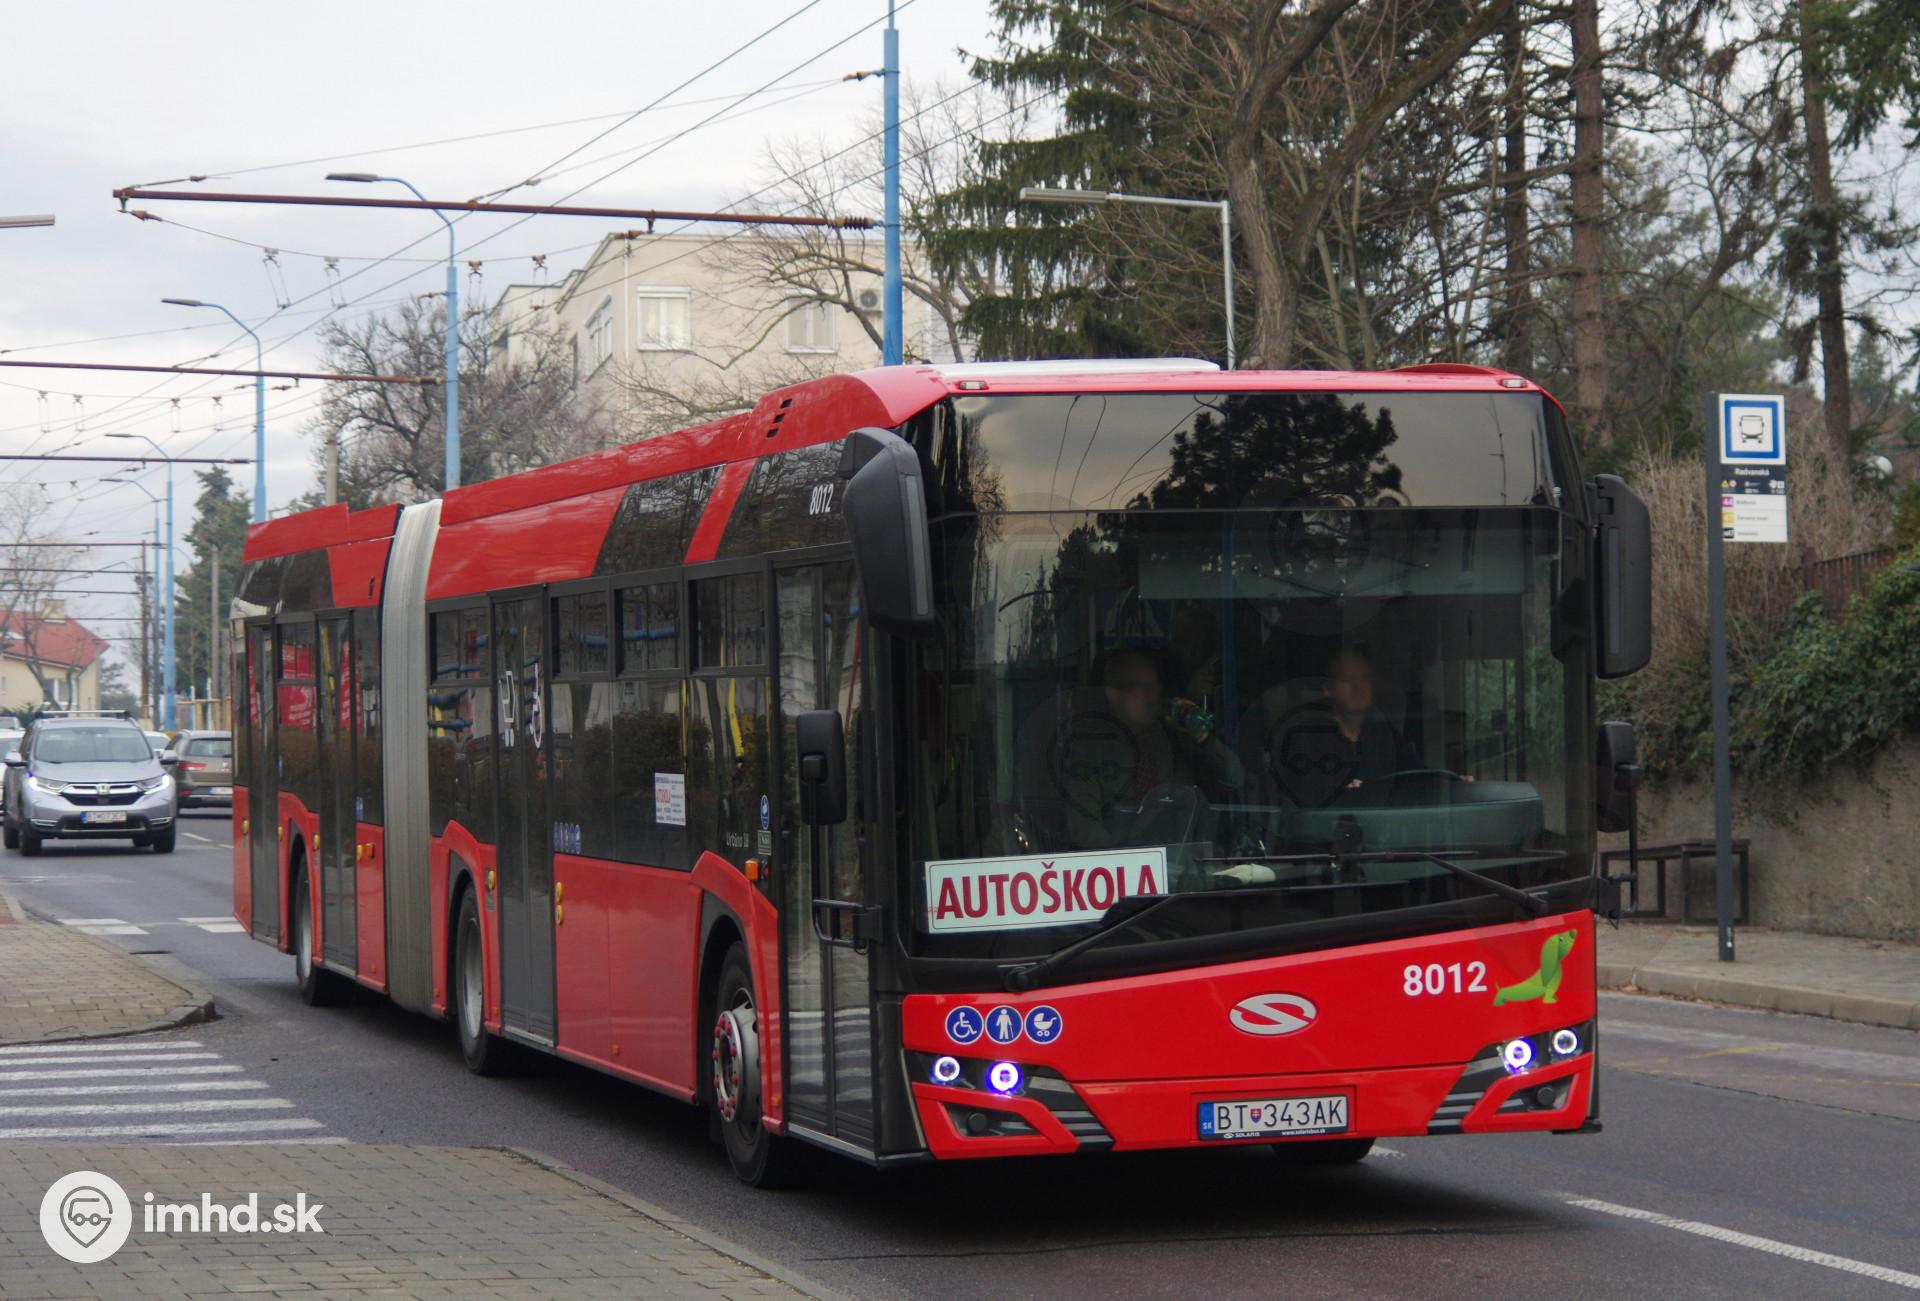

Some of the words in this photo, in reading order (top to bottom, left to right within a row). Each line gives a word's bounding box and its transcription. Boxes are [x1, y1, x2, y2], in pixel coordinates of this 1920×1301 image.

[809, 483, 834, 515] 8012
[936, 861, 1159, 920] AUTOŠKOLA
[1403, 960, 1488, 997] 8012
